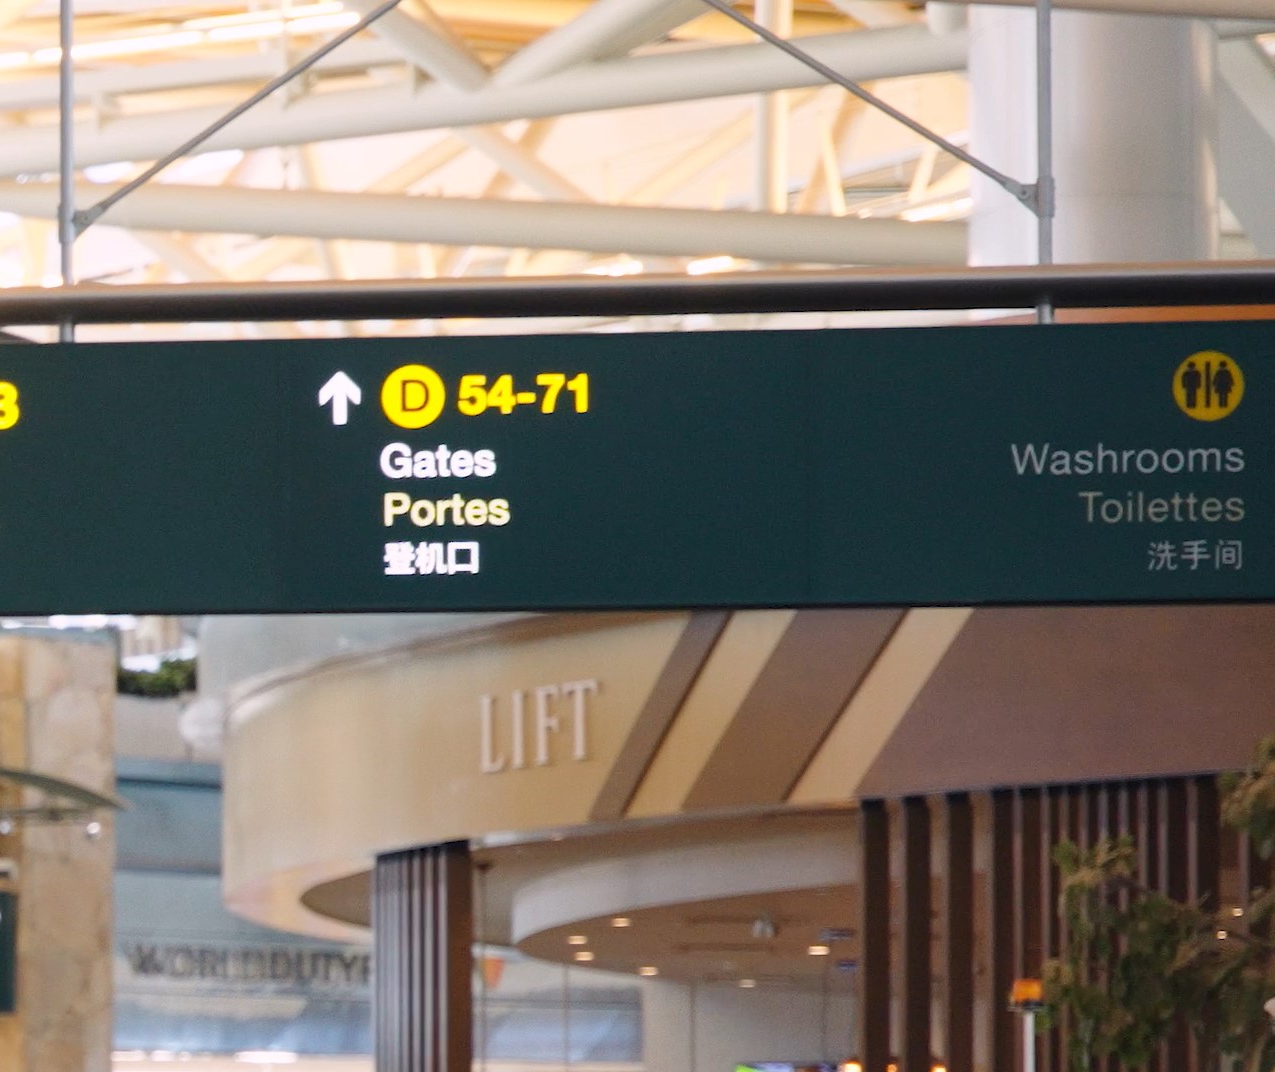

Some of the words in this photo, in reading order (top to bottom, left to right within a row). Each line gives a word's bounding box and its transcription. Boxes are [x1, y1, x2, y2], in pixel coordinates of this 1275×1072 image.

[401, 378, 430, 412] D
[458, 373, 589, 416] 54-71
[380, 442, 497, 479] Gates
[1011, 442, 1245, 475] Washrooms
[384, 493, 510, 527] Portes
[1078, 491, 1245, 523] Toilettes
[383, 541, 480, 576] 登机口
[1147, 540, 1243, 571] 洗手间
[478, 678, 598, 773] LIFT
